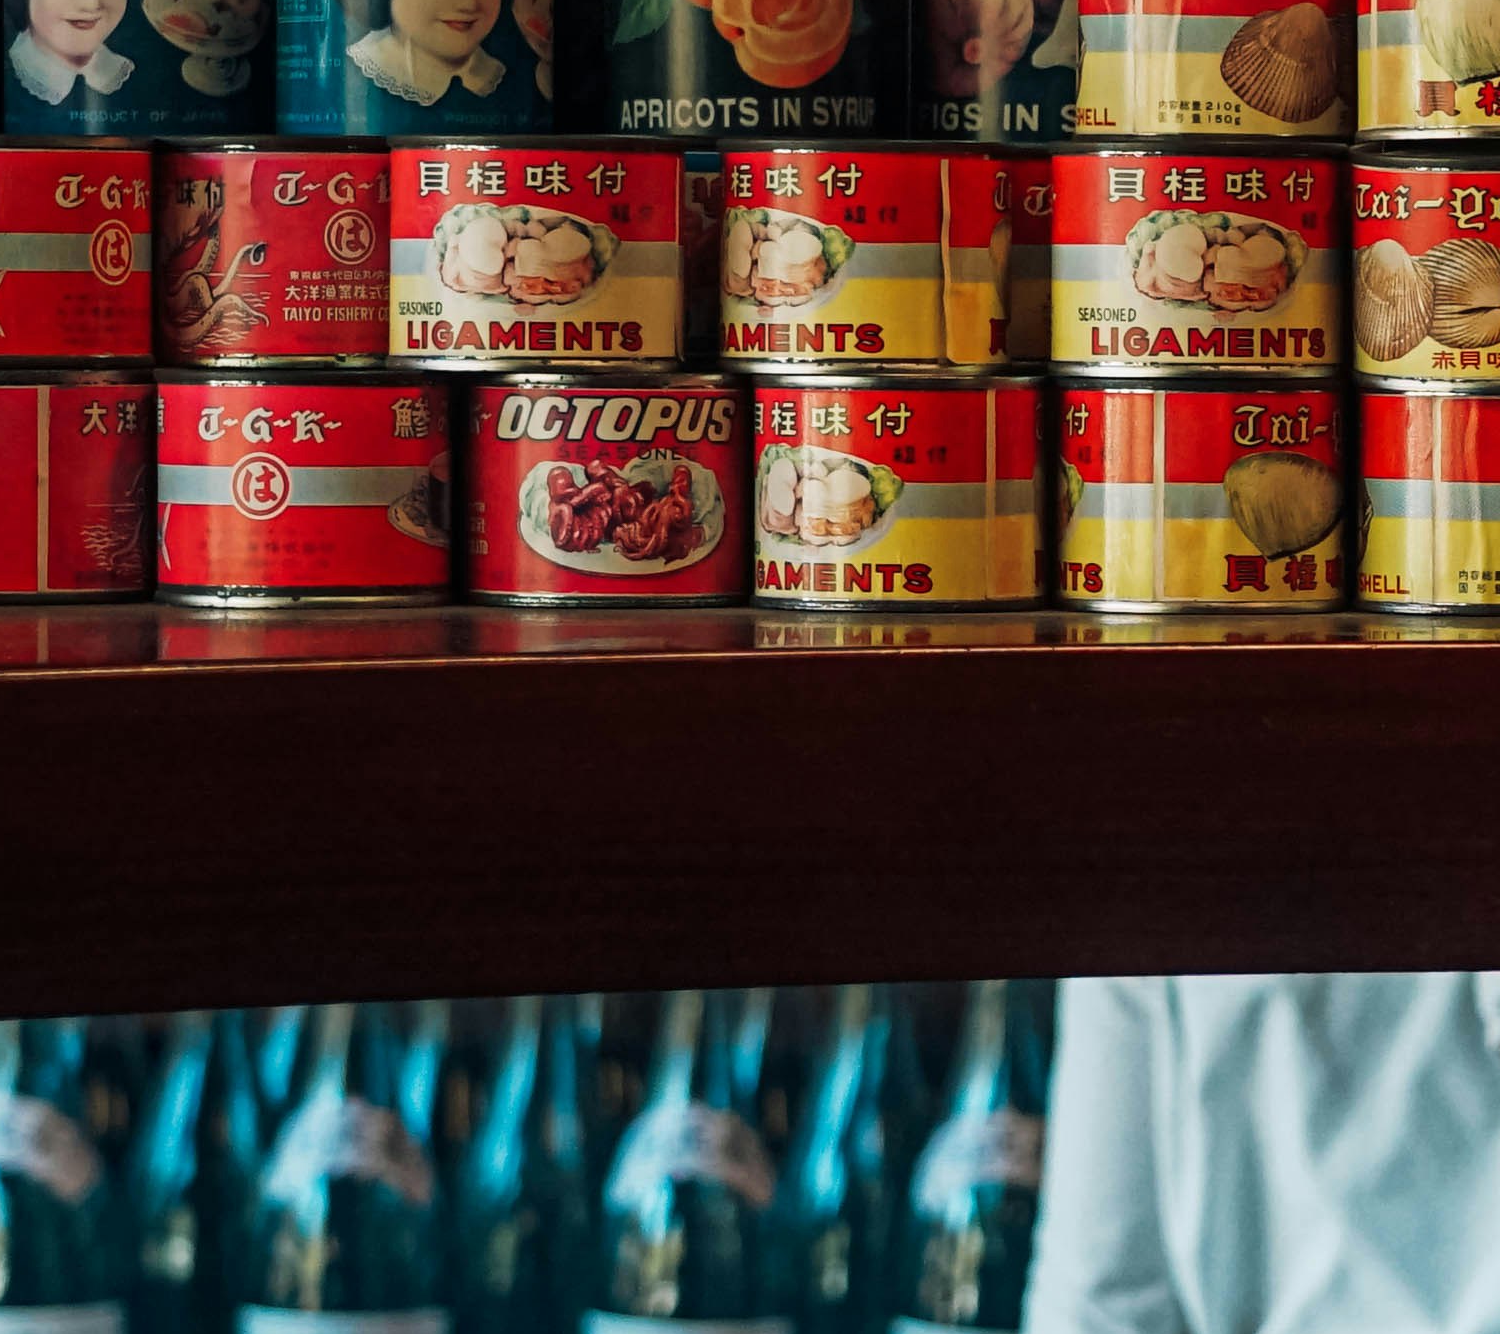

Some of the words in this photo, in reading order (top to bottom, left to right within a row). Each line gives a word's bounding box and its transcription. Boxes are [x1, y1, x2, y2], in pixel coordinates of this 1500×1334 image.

[620, 95, 763, 132] APRICOTS
[772, 97, 801, 129] IN
[1002, 102, 1041, 134] IN
[418, 161, 628, 200] 貝柱味付
[1106, 166, 1316, 204] 貝柱味付
[282, 307, 322, 322] TAIYO
[327, 307, 375, 322] FISHERY
[398, 301, 443, 316] SEASONED
[1077, 306, 1138, 323] SEASONED
[406, 320, 644, 353] LIGAMENTS
[1091, 327, 1326, 359] LIGAMENTS
[497, 394, 736, 443] OCTOPUS
